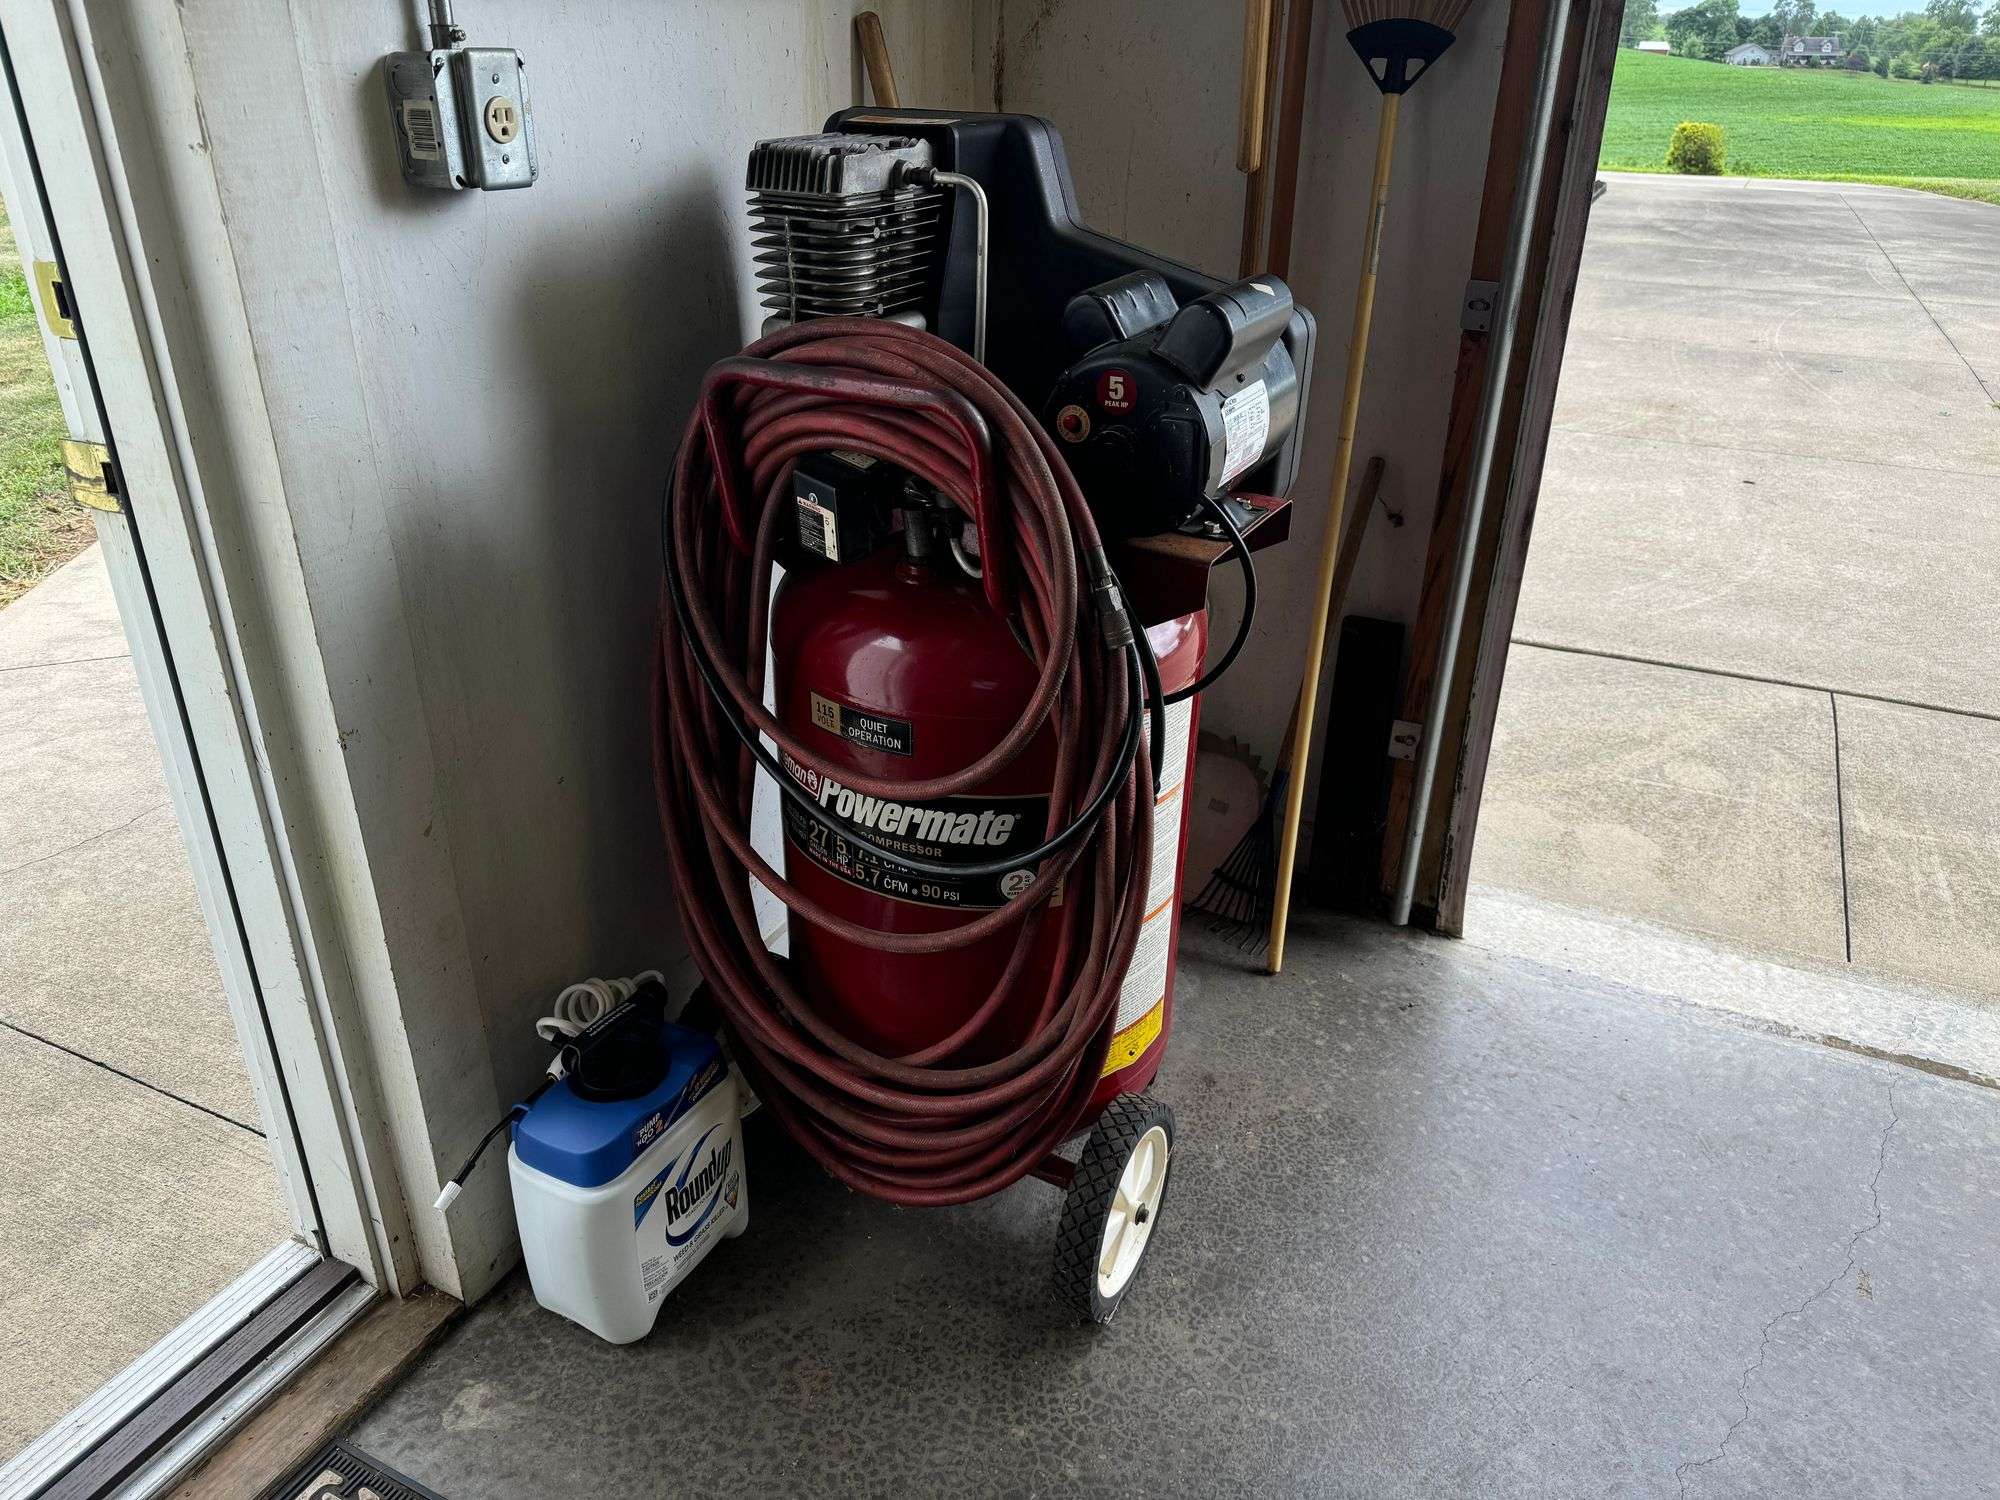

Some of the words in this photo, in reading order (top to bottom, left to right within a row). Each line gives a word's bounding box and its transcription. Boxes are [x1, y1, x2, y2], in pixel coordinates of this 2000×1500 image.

[1109, 375, 1124, 400] 5
[1104, 399, 1120, 408] PEAK
[816, 702, 835, 719] 115
[817, 713, 835, 729] VOLT
[859, 718, 888, 734] QUIET
[848, 726, 902, 750] OPERATION
[783, 752, 807, 784] eman
[819, 776, 1015, 847] Powermate
[809, 820, 829, 847] 27
[836, 834, 848, 854] 5
[836, 851, 849, 866] HP
[855, 863, 881, 887] 5.7
[884, 878, 909, 894] CFM
[921, 884, 941, 899] 90
[943, 891, 961, 901] PSI
[1008, 874, 1024, 891] 2
[664, 1135, 732, 1227] Roundup
